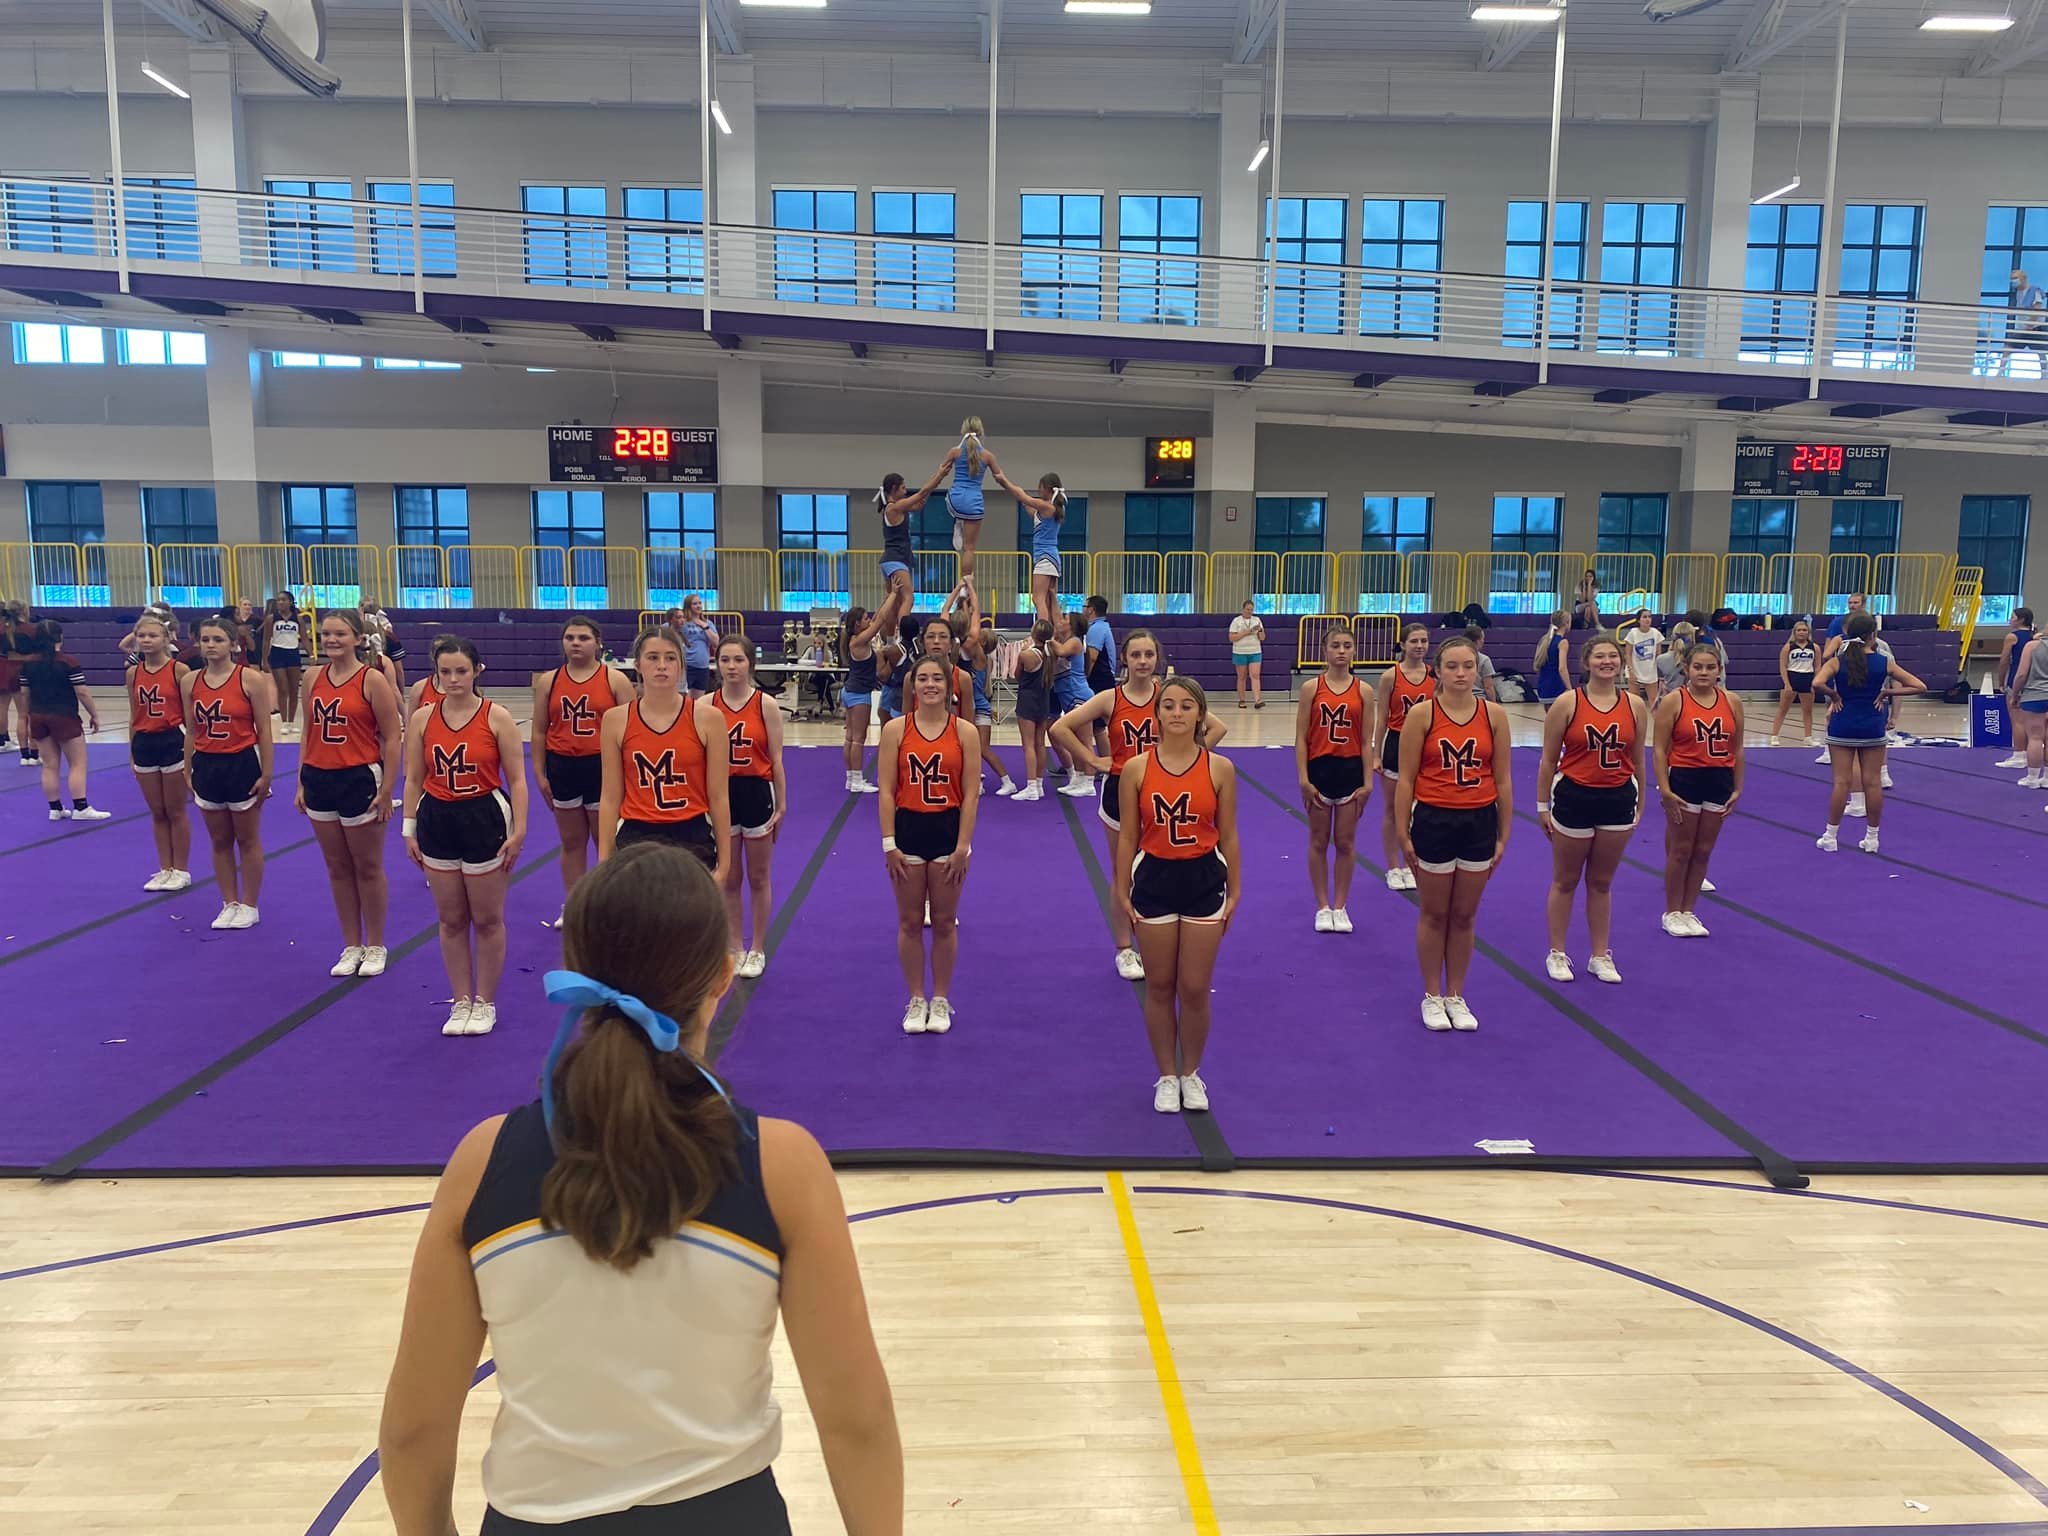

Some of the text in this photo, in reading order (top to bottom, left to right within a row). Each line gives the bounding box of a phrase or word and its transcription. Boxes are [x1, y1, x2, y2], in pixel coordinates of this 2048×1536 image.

[552, 430, 593, 441] HOME
[615, 429, 668, 456] 2:28
[671, 431, 714, 442] GUEST
[1159, 440, 1193, 459] 2:28
[1737, 446, 1775, 457] HOME
[1846, 447, 1886, 458] GUEST
[1792, 446, 1842, 471] 2:28
[1791, 651, 1813, 659] UCA
[138, 685, 165, 718] MC
[194, 699, 231, 740] MC
[312, 697, 347, 744] MC
[560, 695, 596, 737] MC
[1984, 709, 2000, 735] ARE
[1319, 702, 1352, 744] MC
[1692, 717, 1730, 758] MC
[1438, 737, 1482, 788] MC
[1584, 722, 1626, 770] MC
[432, 742, 479, 795] MC
[633, 749, 689, 810] MC
[907, 752, 950, 807] MC
[1152, 791, 1198, 848] MC
